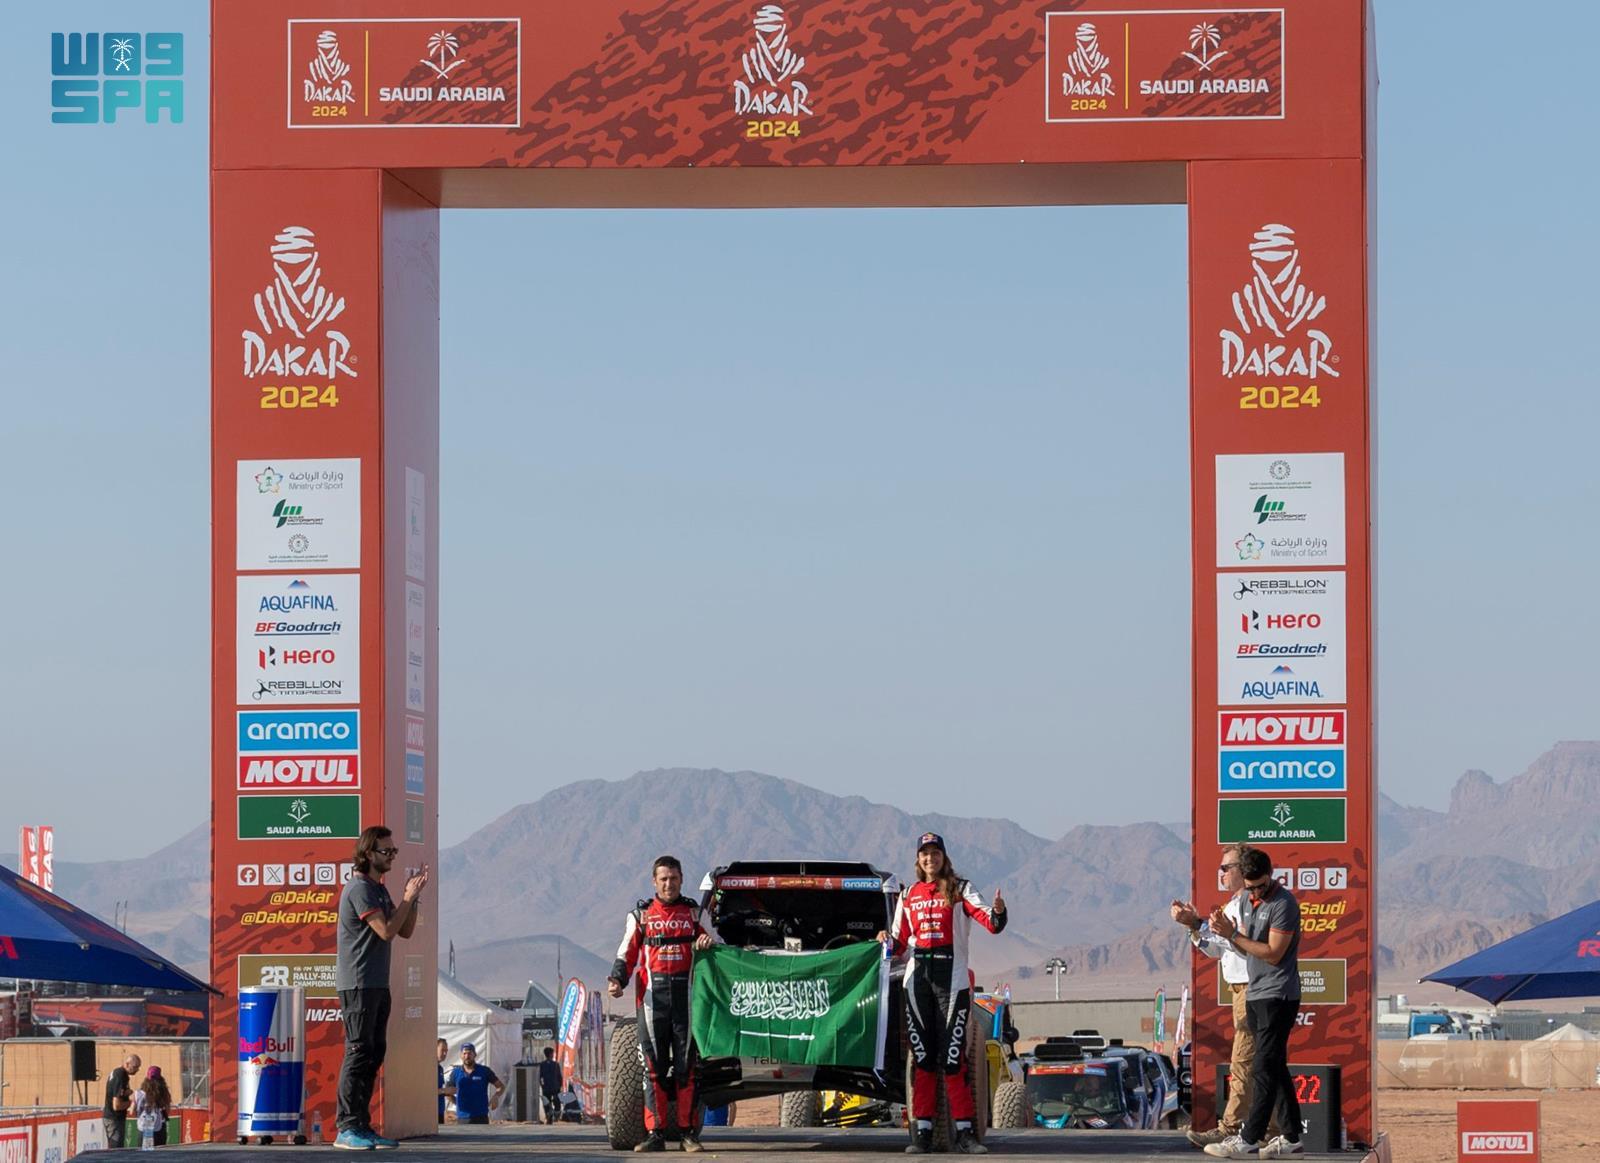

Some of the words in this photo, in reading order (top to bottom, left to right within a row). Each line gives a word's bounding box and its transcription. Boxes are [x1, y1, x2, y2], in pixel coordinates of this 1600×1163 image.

[304, 79, 355, 103] DAKAR
[1062, 72, 1115, 96] DAKAR
[1140, 79, 1194, 95] SAUDI
[1199, 79, 1269, 94] ARABIA
[379, 87, 433, 102] SAUDI
[437, 86, 506, 102] ARABIA
[733, 80, 813, 116] DAKAR
[312, 105, 348, 117] 2024
[1071, 99, 1107, 111] 2024
[746, 121, 801, 138] 2024
[242, 330, 358, 379] DAKAR
[1219, 329, 1340, 379] DAKAR
[260, 385, 339, 409] 2024
[1239, 385, 1321, 409] 2024
[322, 471, 344, 481] وزارة
[324, 483, 343, 491] Sport
[1271, 537, 1302, 547] الرياضة
[1305, 537, 1327, 547] وزارة
[1307, 549, 1327, 557] Sport
[1250, 580, 1326, 589] REBELLION
[259, 595, 335, 613] AQUAFINA
[255, 621, 341, 633] BFGoodrich
[1237, 643, 1327, 655] BFGoodrich
[268, 680, 342, 689] REBELLION
[1241, 681, 1320, 699] AQUAFINA
[247, 722, 350, 741] aramco
[1226, 717, 1339, 742] MOTUL
[245, 759, 354, 783] MOTUL
[1228, 760, 1336, 779] aramco
[296, 826, 332, 834] ARABIA
[1248, 830, 1277, 839] SAUDI
[1279, 829, 1316, 838] ARABIA
[720, 879, 756, 887] MOTUL
[844, 880, 880, 889] aramco
[270, 890, 334, 905] @Dakar
[1299, 900, 1347, 915] Saudi
[240, 910, 338, 926] @DakarInSa
[648, 920, 691, 930] TOYOTA
[559, 985, 577, 1040] aramco
[267, 1036, 295, 1053] Bull
[947, 1008, 968, 1065] TOYOTA
[1470, 1135, 1525, 1150] MOTUL
